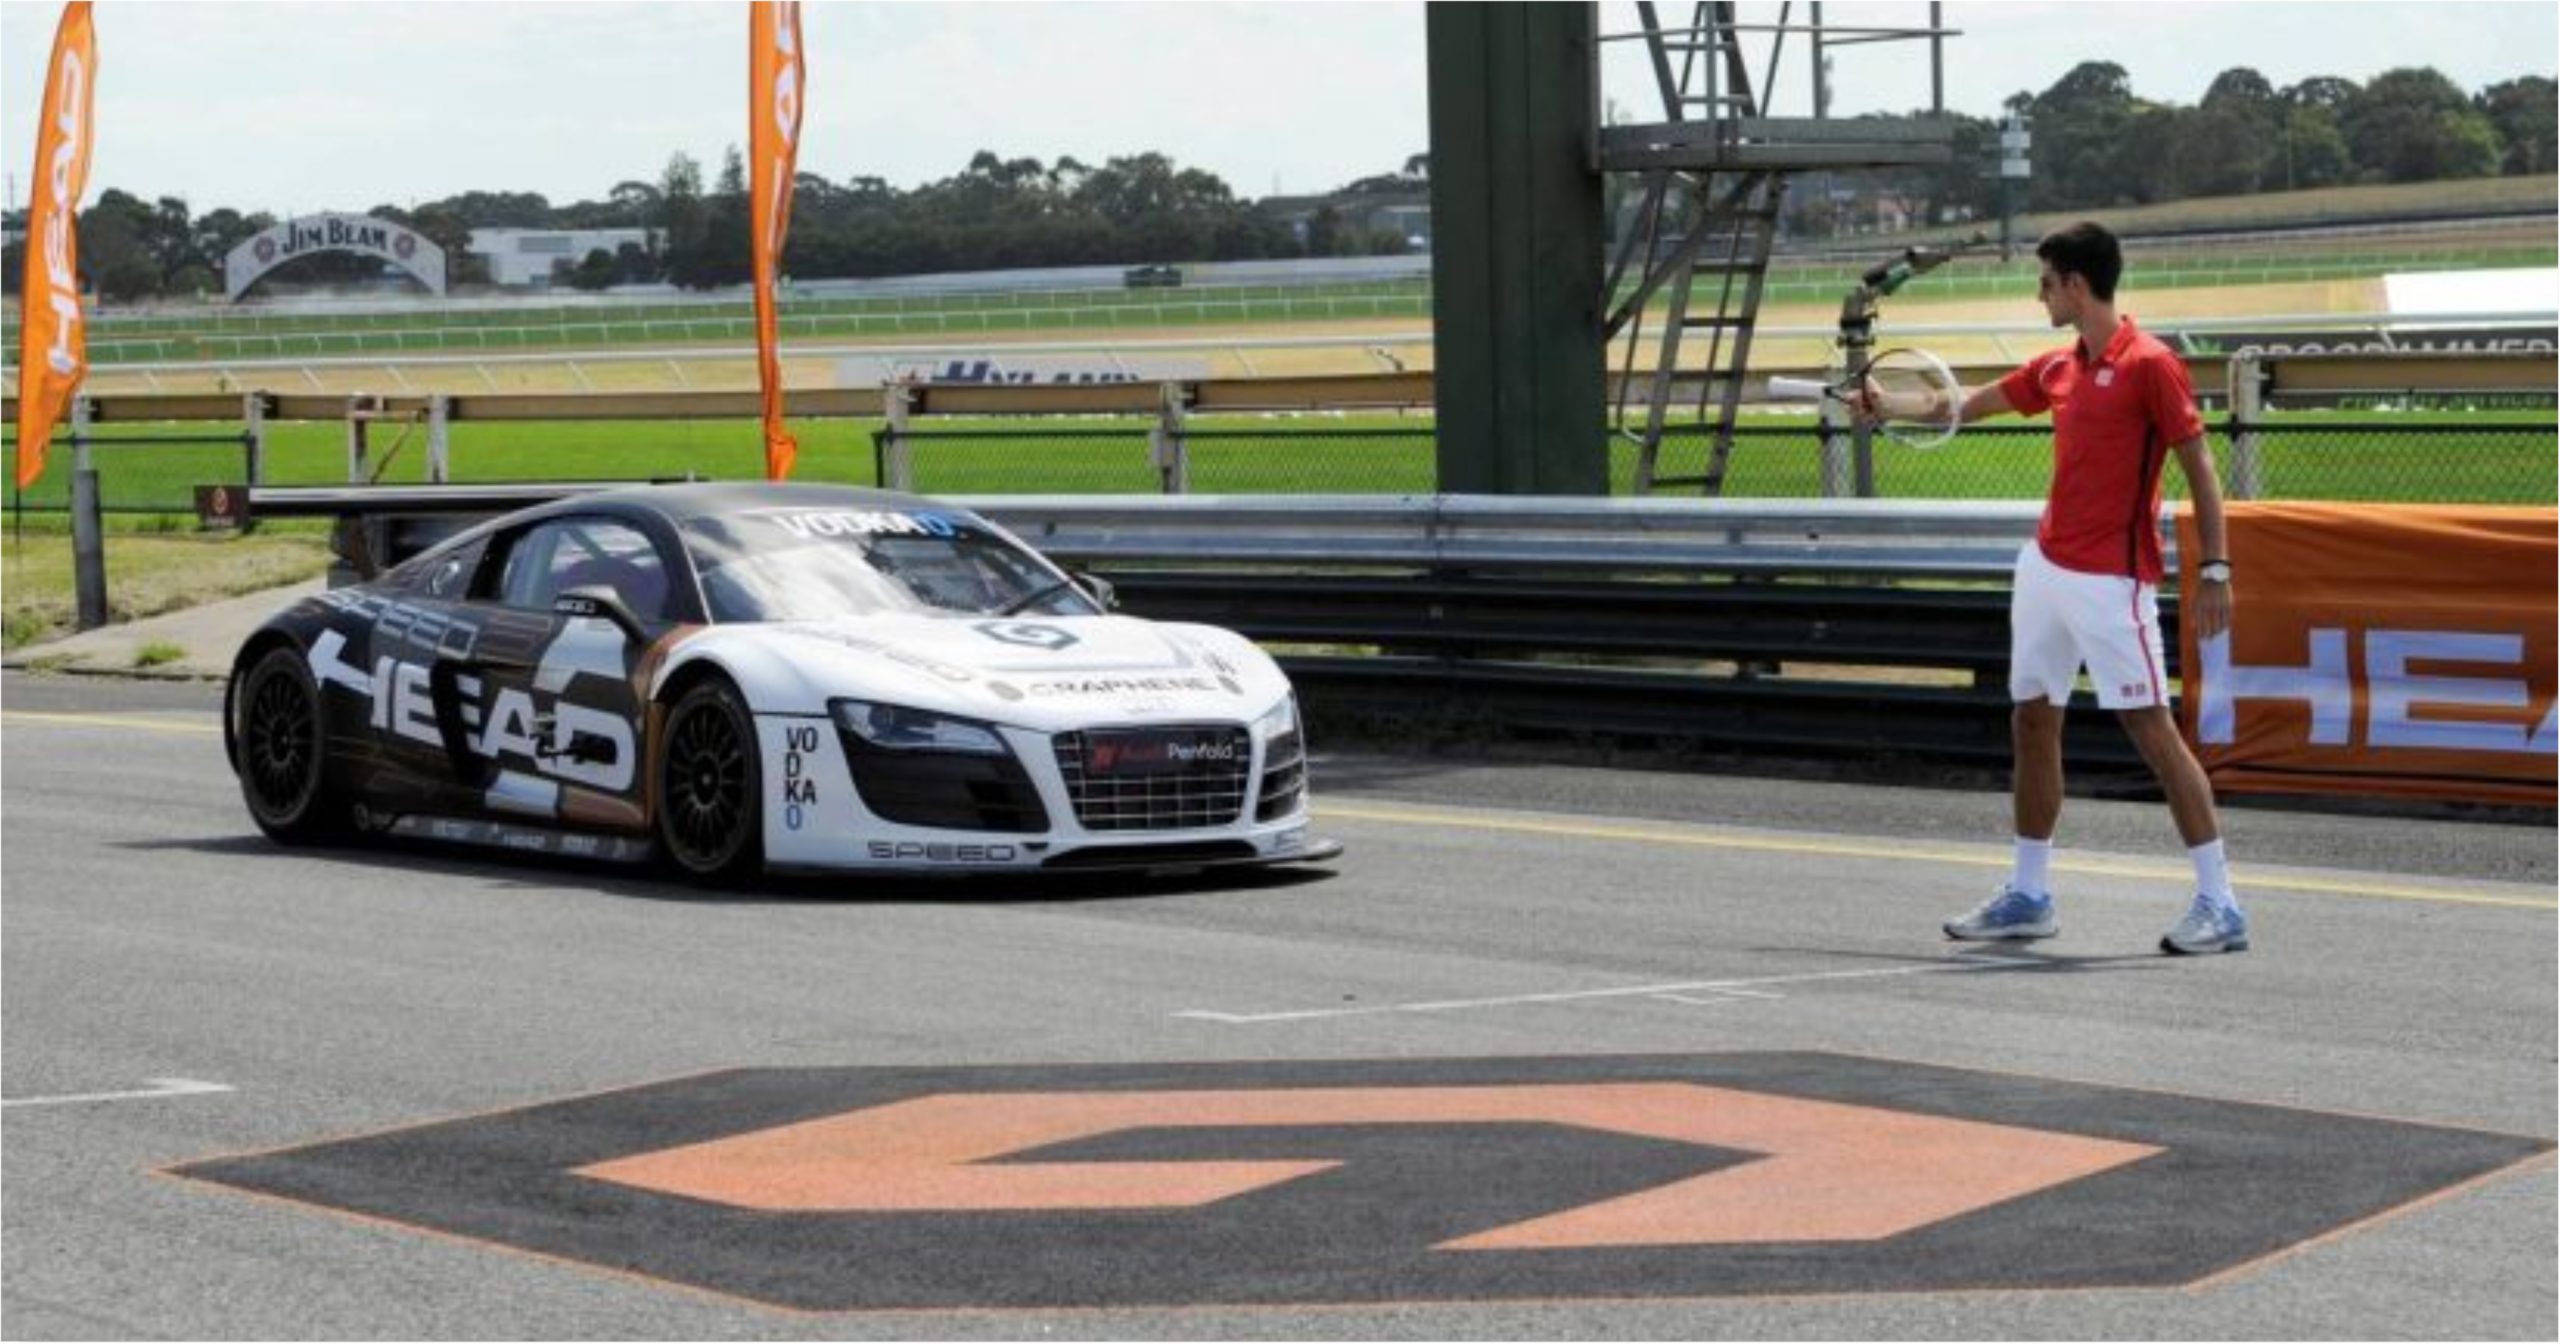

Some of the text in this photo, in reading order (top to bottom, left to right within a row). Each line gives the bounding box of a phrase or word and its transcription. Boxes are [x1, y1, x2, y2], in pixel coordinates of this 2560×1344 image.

[43, 48, 82, 374] HEAD
[283, 217, 388, 254] JIM BEAM
[2198, 627, 2558, 752] HE
[307, 627, 636, 792] HEAD
[786, 726, 819, 753] VO
[1167, 742, 1234, 761] Penfold
[785, 779, 817, 805] KA
[867, 842, 1015, 861] SPEED
